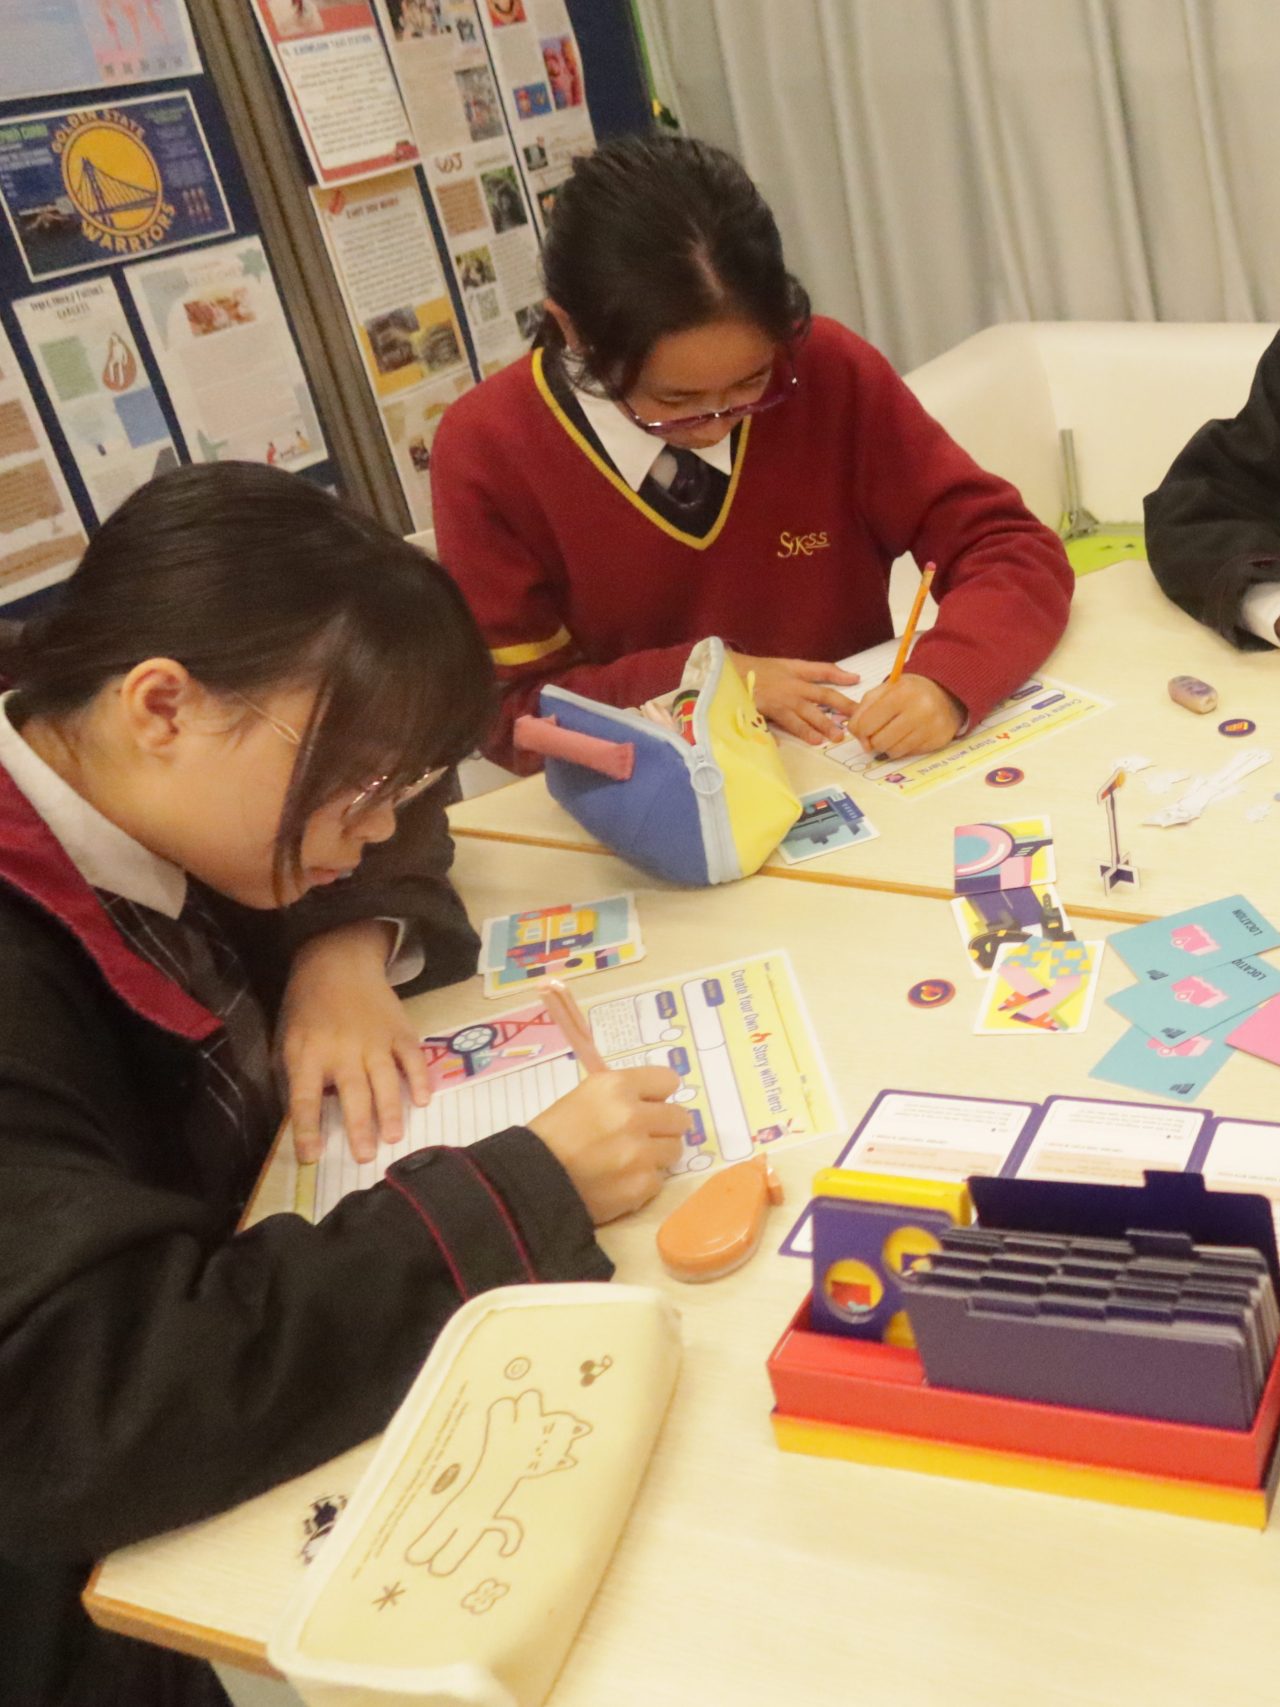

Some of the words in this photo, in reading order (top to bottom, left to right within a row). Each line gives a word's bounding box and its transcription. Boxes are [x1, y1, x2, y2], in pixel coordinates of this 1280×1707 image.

[51, 110, 98, 153] GOLDEN
[103, 108, 146, 139] STATE
[81, 203, 176, 252] WARRIORS
[1232, 909, 1263, 936] LOCATION
[731, 969, 748, 995] Create
[1231, 958, 1267, 981] LOCATIO
[739, 993, 753, 1013] Your
[744, 1013, 759, 1033] Own
[752, 1044, 769, 1068] Story
[760, 1067, 778, 1088] with
[765, 1086, 788, 1115] Fiero!
